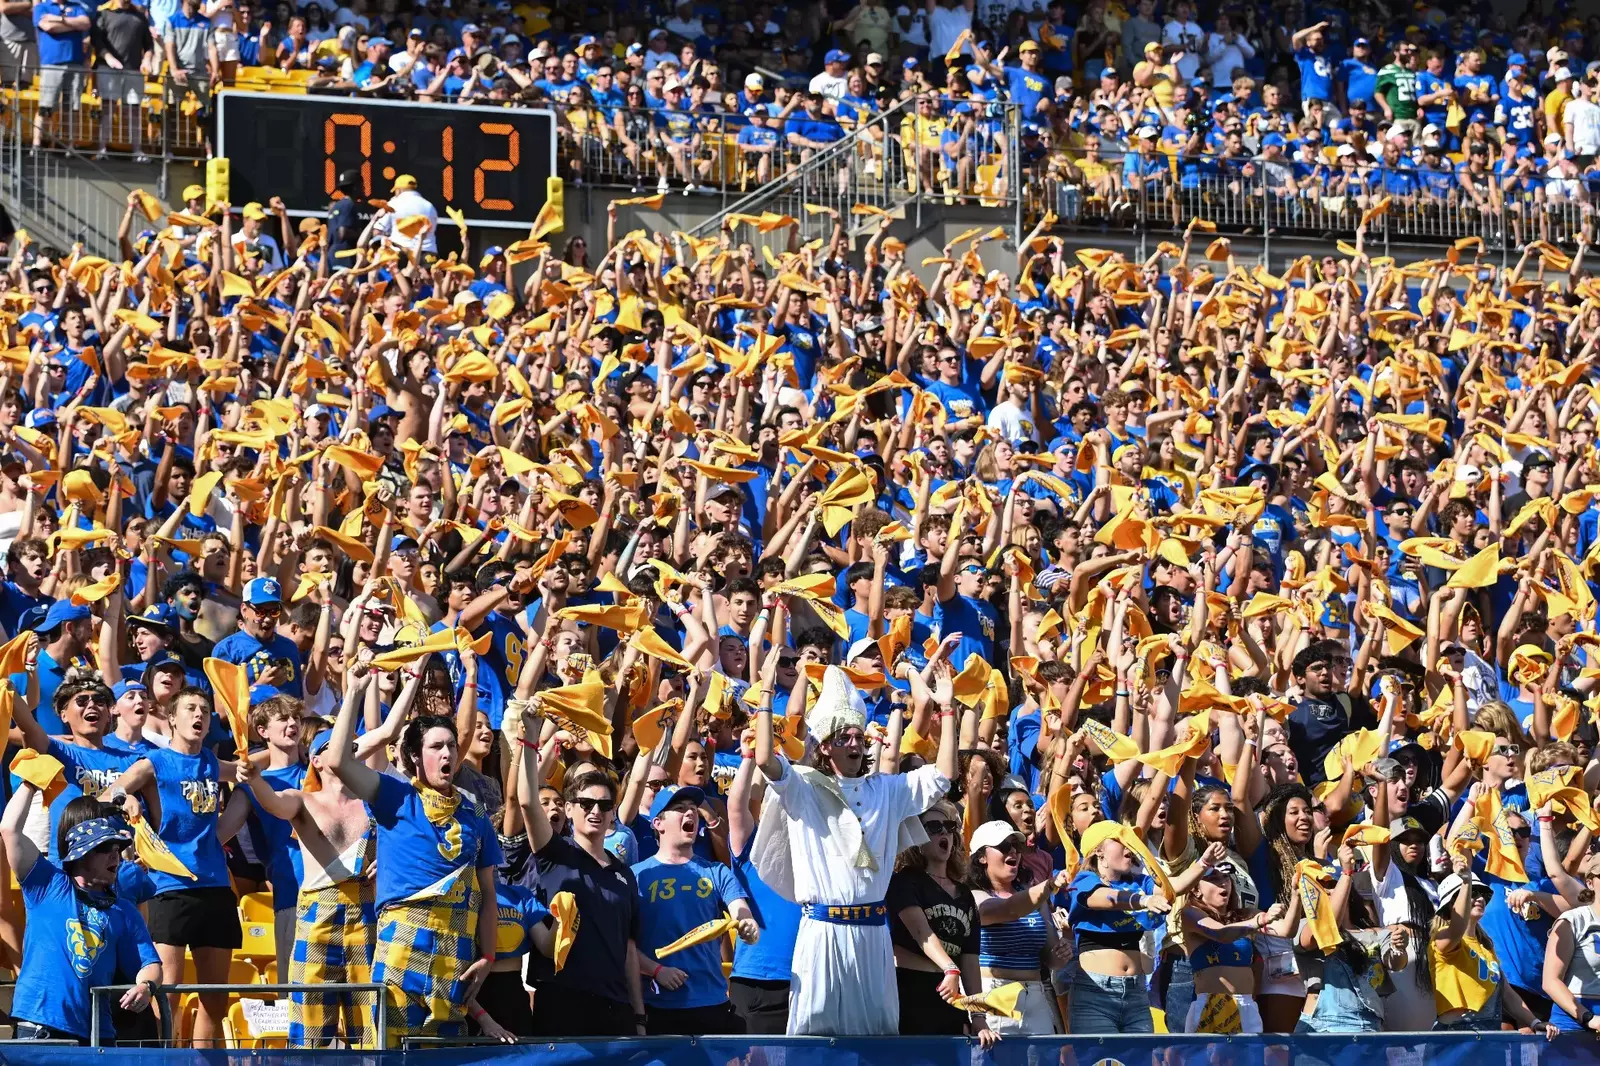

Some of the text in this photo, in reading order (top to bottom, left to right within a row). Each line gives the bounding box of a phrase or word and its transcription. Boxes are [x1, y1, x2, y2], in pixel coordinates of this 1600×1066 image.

[1510, 106, 1533, 130] 33
[325, 113, 520, 210] 0:12
[76, 765, 124, 785] PANTHE
[437, 816, 462, 862] 3
[829, 905, 871, 920] PITT
